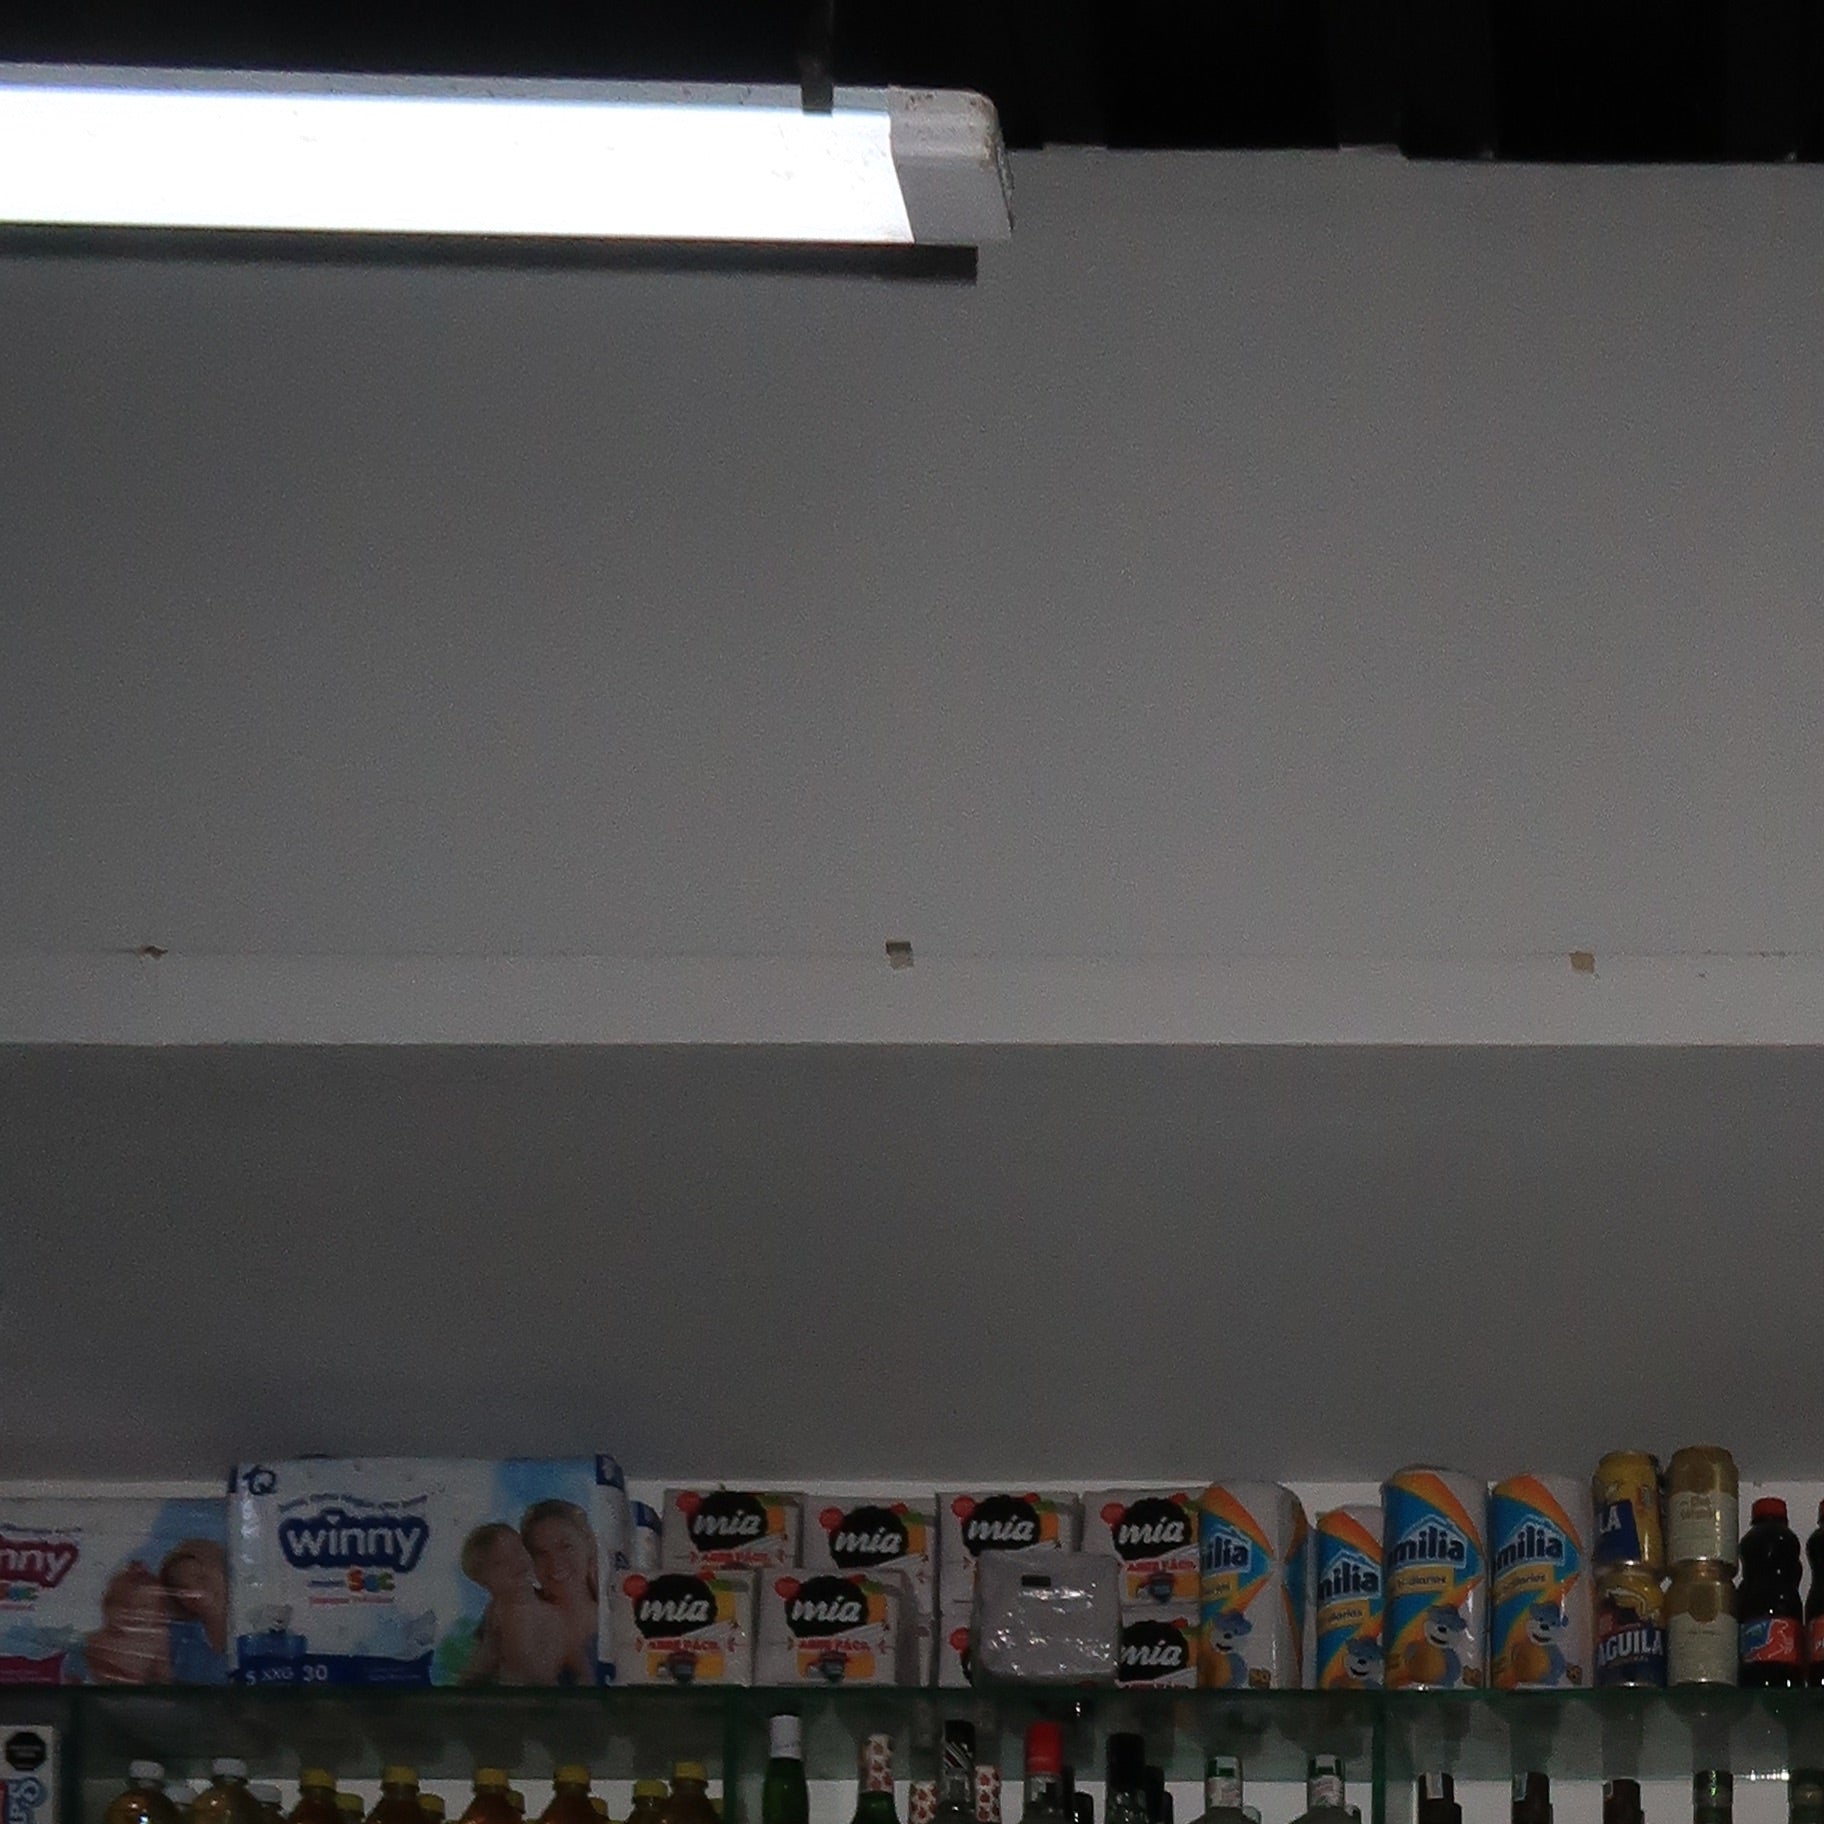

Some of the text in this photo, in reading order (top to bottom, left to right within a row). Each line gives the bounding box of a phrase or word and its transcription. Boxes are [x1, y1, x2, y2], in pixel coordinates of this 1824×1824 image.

[285, 1517, 420, 1560] winny
[1388, 1532, 1466, 1569] milia
[302, 1664, 329, 1682] 30
